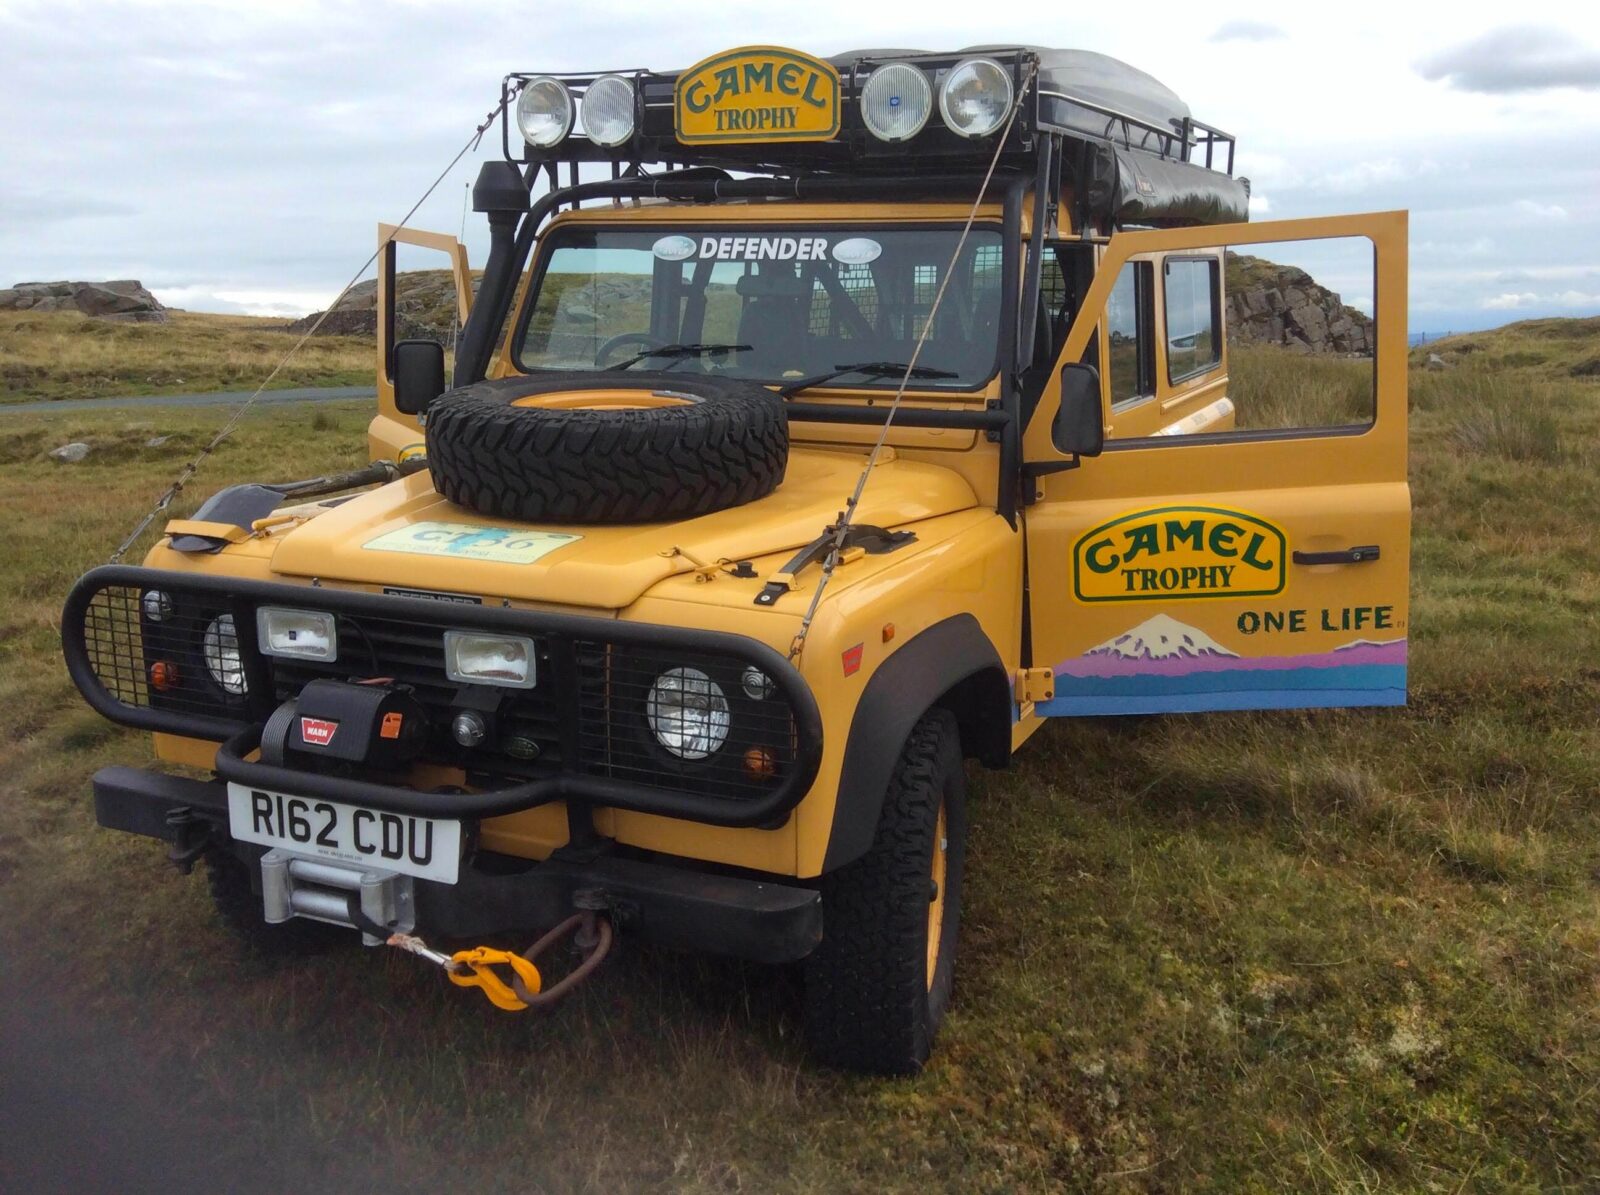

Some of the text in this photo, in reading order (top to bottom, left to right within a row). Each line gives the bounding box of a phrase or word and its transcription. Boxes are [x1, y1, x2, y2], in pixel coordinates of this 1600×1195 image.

[685, 62, 827, 114] CAMEL
[713, 106, 800, 131] TROPHY
[698, 237, 828, 261] DEFENDER
[1084, 519, 1274, 573] CAMEL
[1121, 565, 1236, 591] TROPHY
[1236, 605, 1394, 635] ONE LIFE
[306, 726, 329, 738] WARN
[250, 790, 434, 866] R162 CDU
